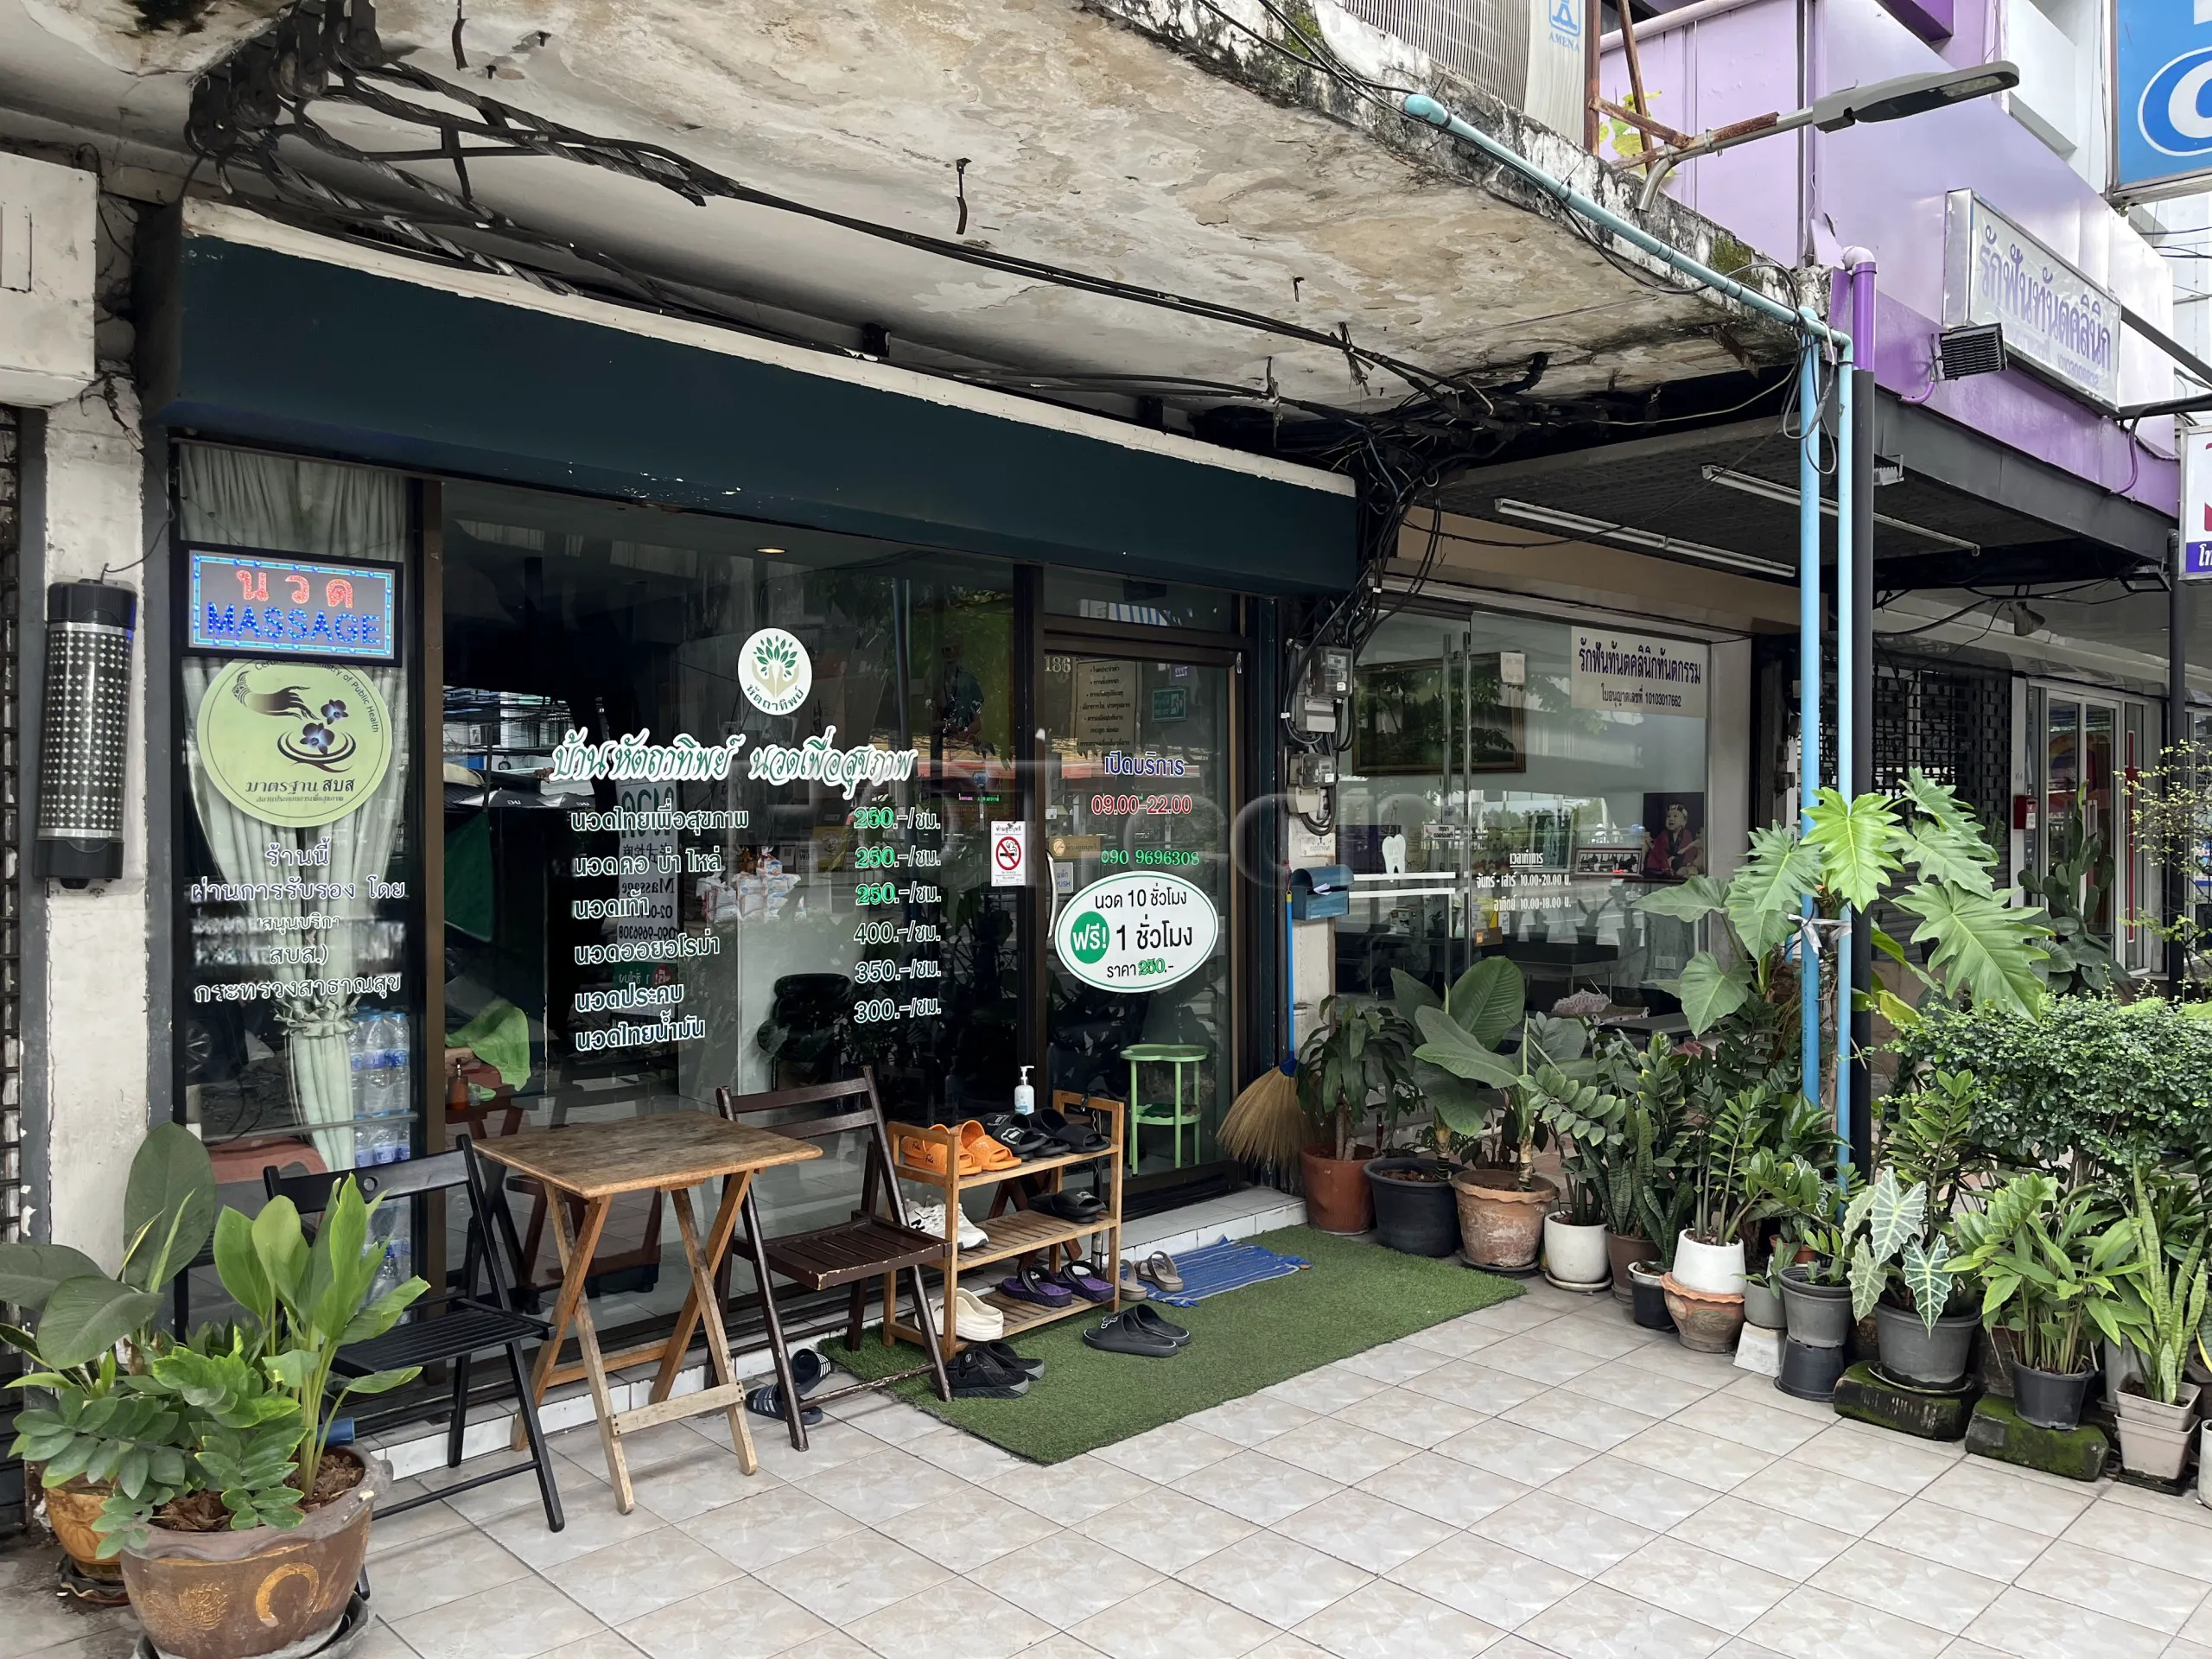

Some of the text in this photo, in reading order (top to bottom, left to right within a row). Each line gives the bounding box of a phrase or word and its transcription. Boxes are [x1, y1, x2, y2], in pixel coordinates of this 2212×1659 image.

[1548, 31, 1580, 53] AMENA
[1979, 224, 2111, 372] รักฟันทันตคลินิก
[207, 601, 381, 645] MASSAGE
[1044, 657, 1071, 673] 186
[1579, 637, 1701, 684] รักฟันทันตคลินิกทันตกรรม
[343, 673, 354, 683] of
[352, 681, 370, 707] Public
[366, 706, 379, 734] Health
[747, 684, 804, 711] หัตถาทิพย์
[748, 725, 918, 801] นวดเพื่อสุขภาพ
[1104, 749, 1185, 778] เปิดบริการ
[245, 779, 355, 795] มาตรฐาน สบส
[570, 798, 749, 836] นวดไทยเพื่อสุขภาพ
[1091, 795, 1192, 816] 09.00-22.00
[264, 836, 331, 867] ร้านนี้
[656, 847, 681, 874] บ่า
[687, 846, 722, 873] ไหล่
[1101, 849, 1200, 866] 090 9696308
[1510, 849, 1544, 865] เวลาทำการ
[190, 874, 405, 901] ผ่านการรับรอง โดย
[1095, 883, 1187, 909] นวด 10 ชั่วโมง
[572, 889, 649, 919] นวดเท้า
[574, 929, 721, 965] นวดออยอโรม่า
[1072, 914, 1193, 951] ฟรี! 1 ชั่วโมง
[575, 983, 684, 1013] นวดประคบ
[575, 1009, 705, 1052] นวดไทยน้ำมัน
